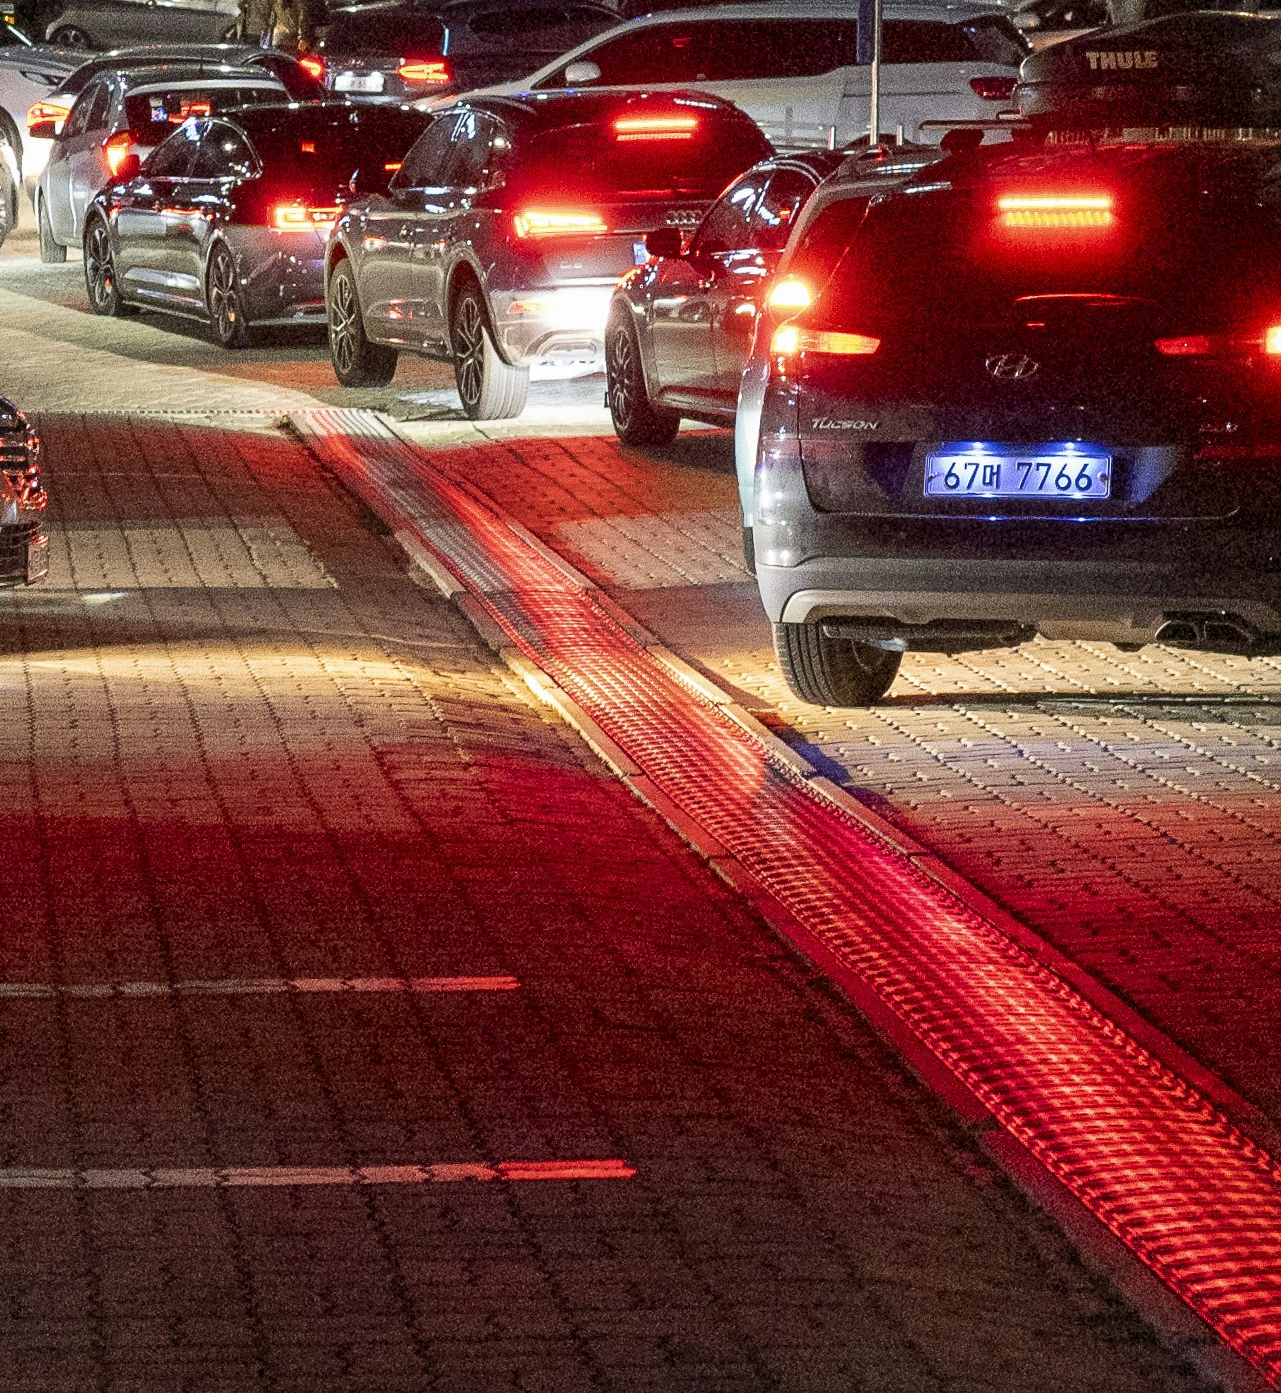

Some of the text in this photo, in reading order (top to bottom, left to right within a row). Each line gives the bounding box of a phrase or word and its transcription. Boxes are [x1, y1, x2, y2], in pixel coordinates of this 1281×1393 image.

[1085, 50, 1159, 70] THULE
[811, 416, 878, 430] TUCSON
[944, 462, 1093, 492] 67머 7766
